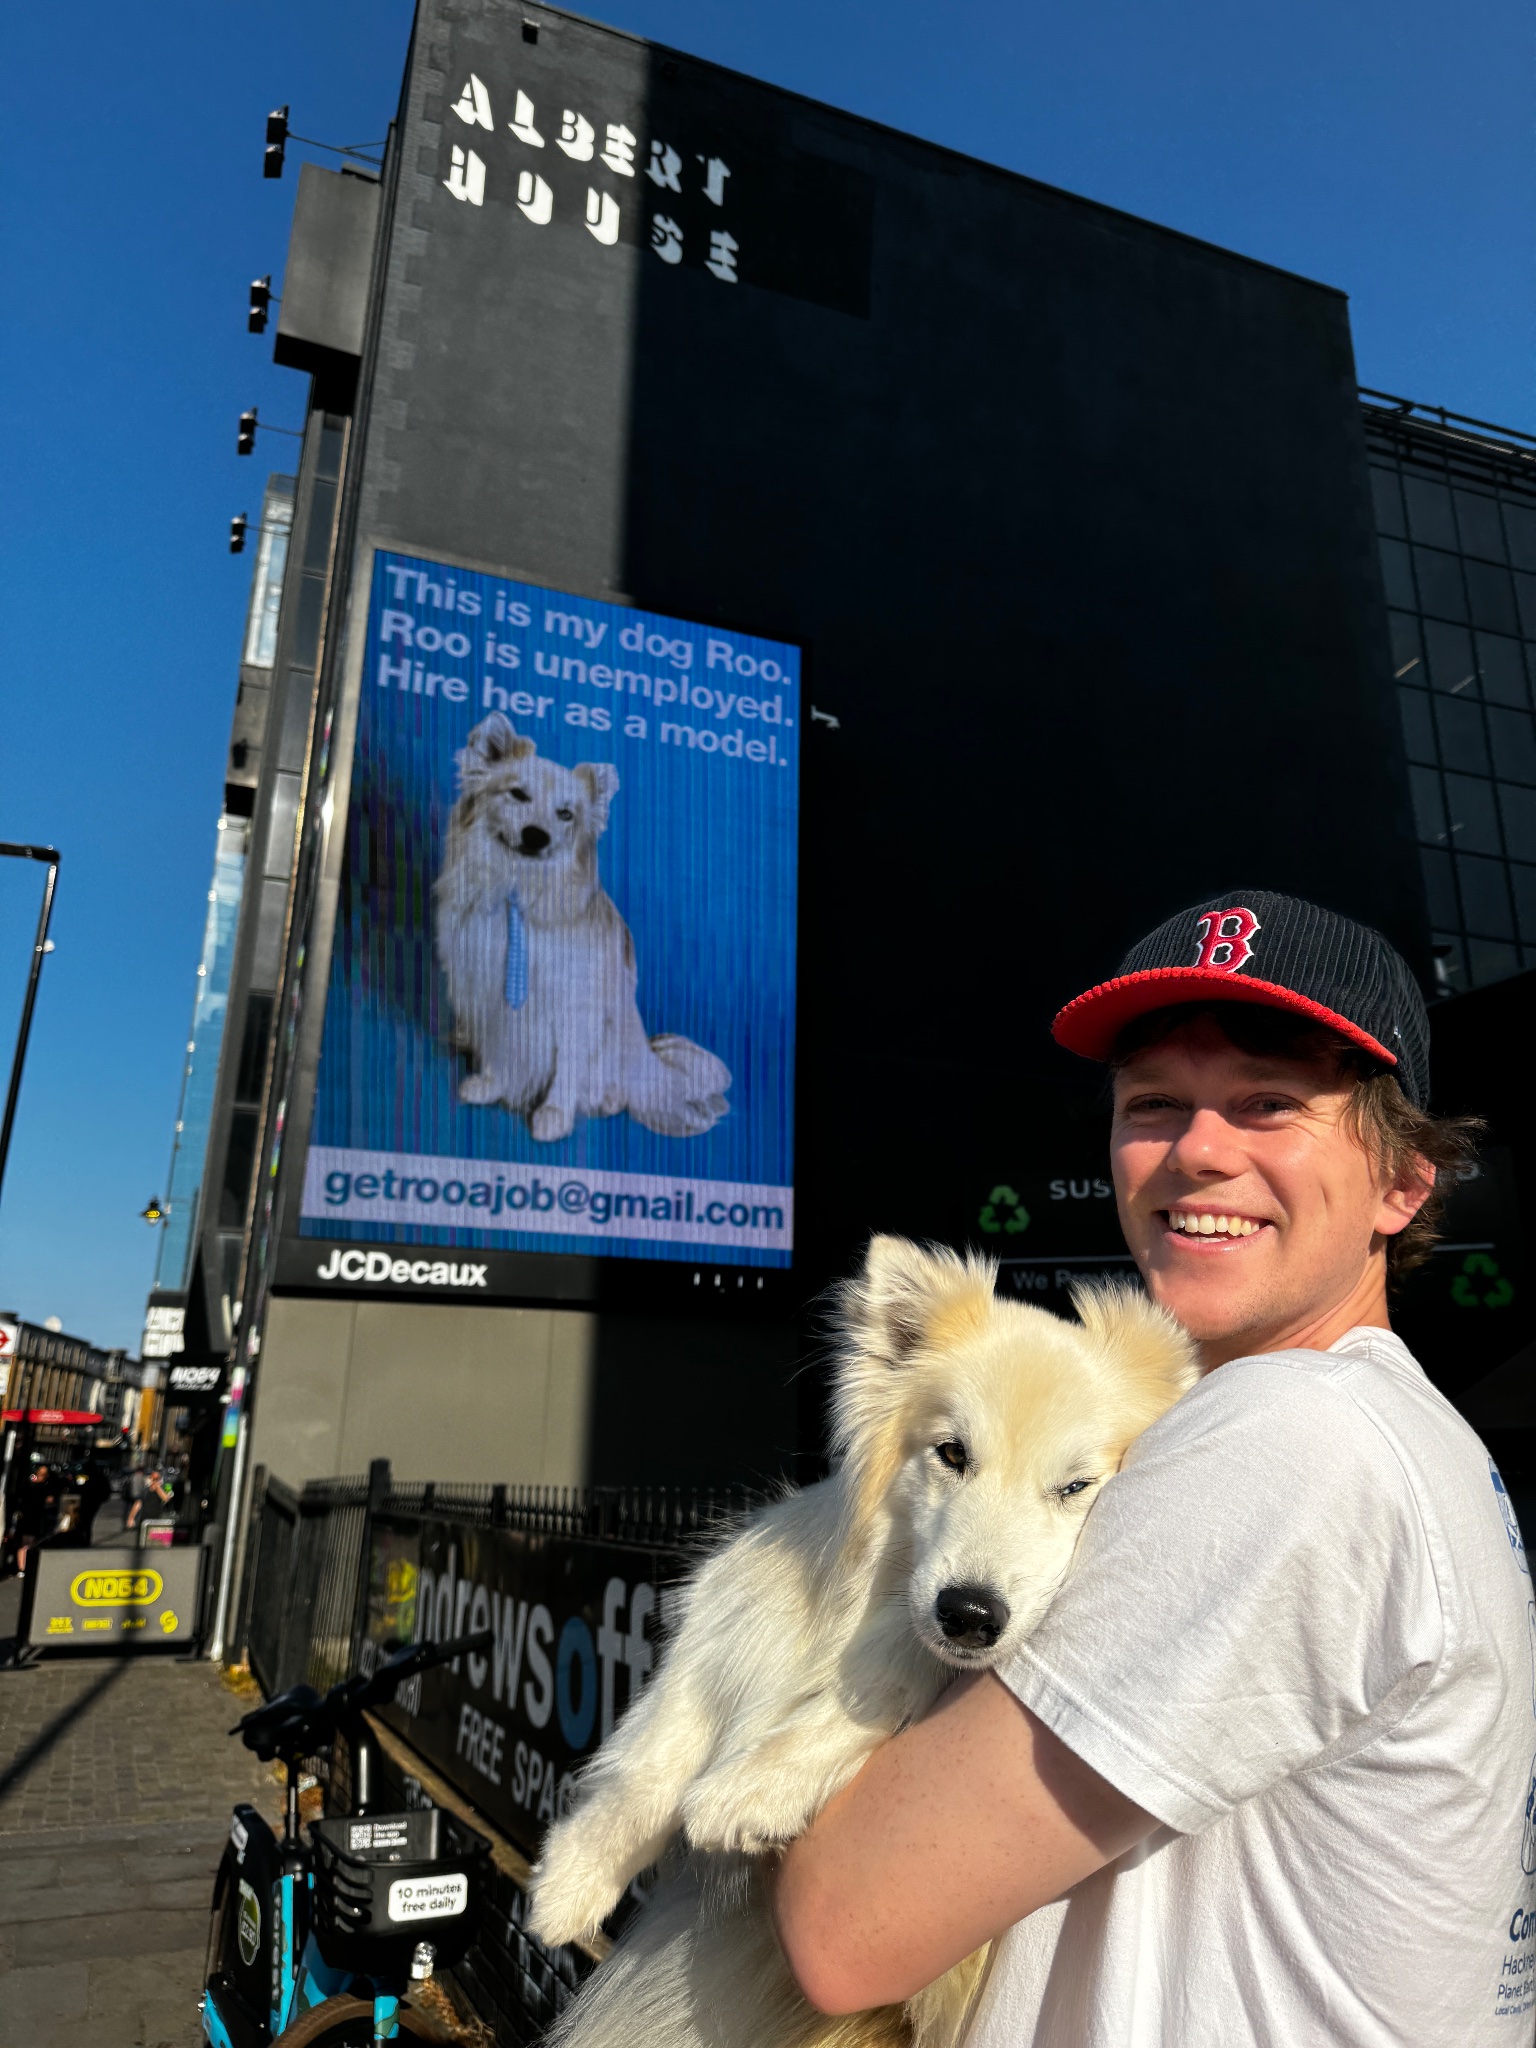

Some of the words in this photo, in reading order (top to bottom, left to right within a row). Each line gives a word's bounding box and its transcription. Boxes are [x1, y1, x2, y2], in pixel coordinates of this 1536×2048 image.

[451, 73, 731, 206] ALBERT
[443, 144, 739, 283] HOUSE
[386, 564, 482, 616] This
[494, 590, 532, 627] is
[544, 605, 608, 649] my
[619, 623, 693, 670] dog
[707, 639, 792, 685] Roo.
[380, 608, 471, 659] Roo
[485, 632, 522, 670] is
[534, 649, 794, 727] unemployed.
[377, 654, 470, 702] Hire
[483, 674, 555, 720] her
[565, 702, 612, 732] as
[624, 714, 648, 740] a
[660, 720, 788, 767] model.
[1193, 907, 1262, 974] B
[324, 1168, 784, 1230] getrooajob@gmail.com
[317, 1249, 488, 1288] JCDecaux
[84, 1576, 149, 1599] NO64
[456, 1701, 507, 1787] FREE
[398, 1887, 413, 1899] 10
[416, 1884, 462, 1898] minutes
[402, 1901, 426, 1913] free
[429, 1896, 456, 1910] daily
